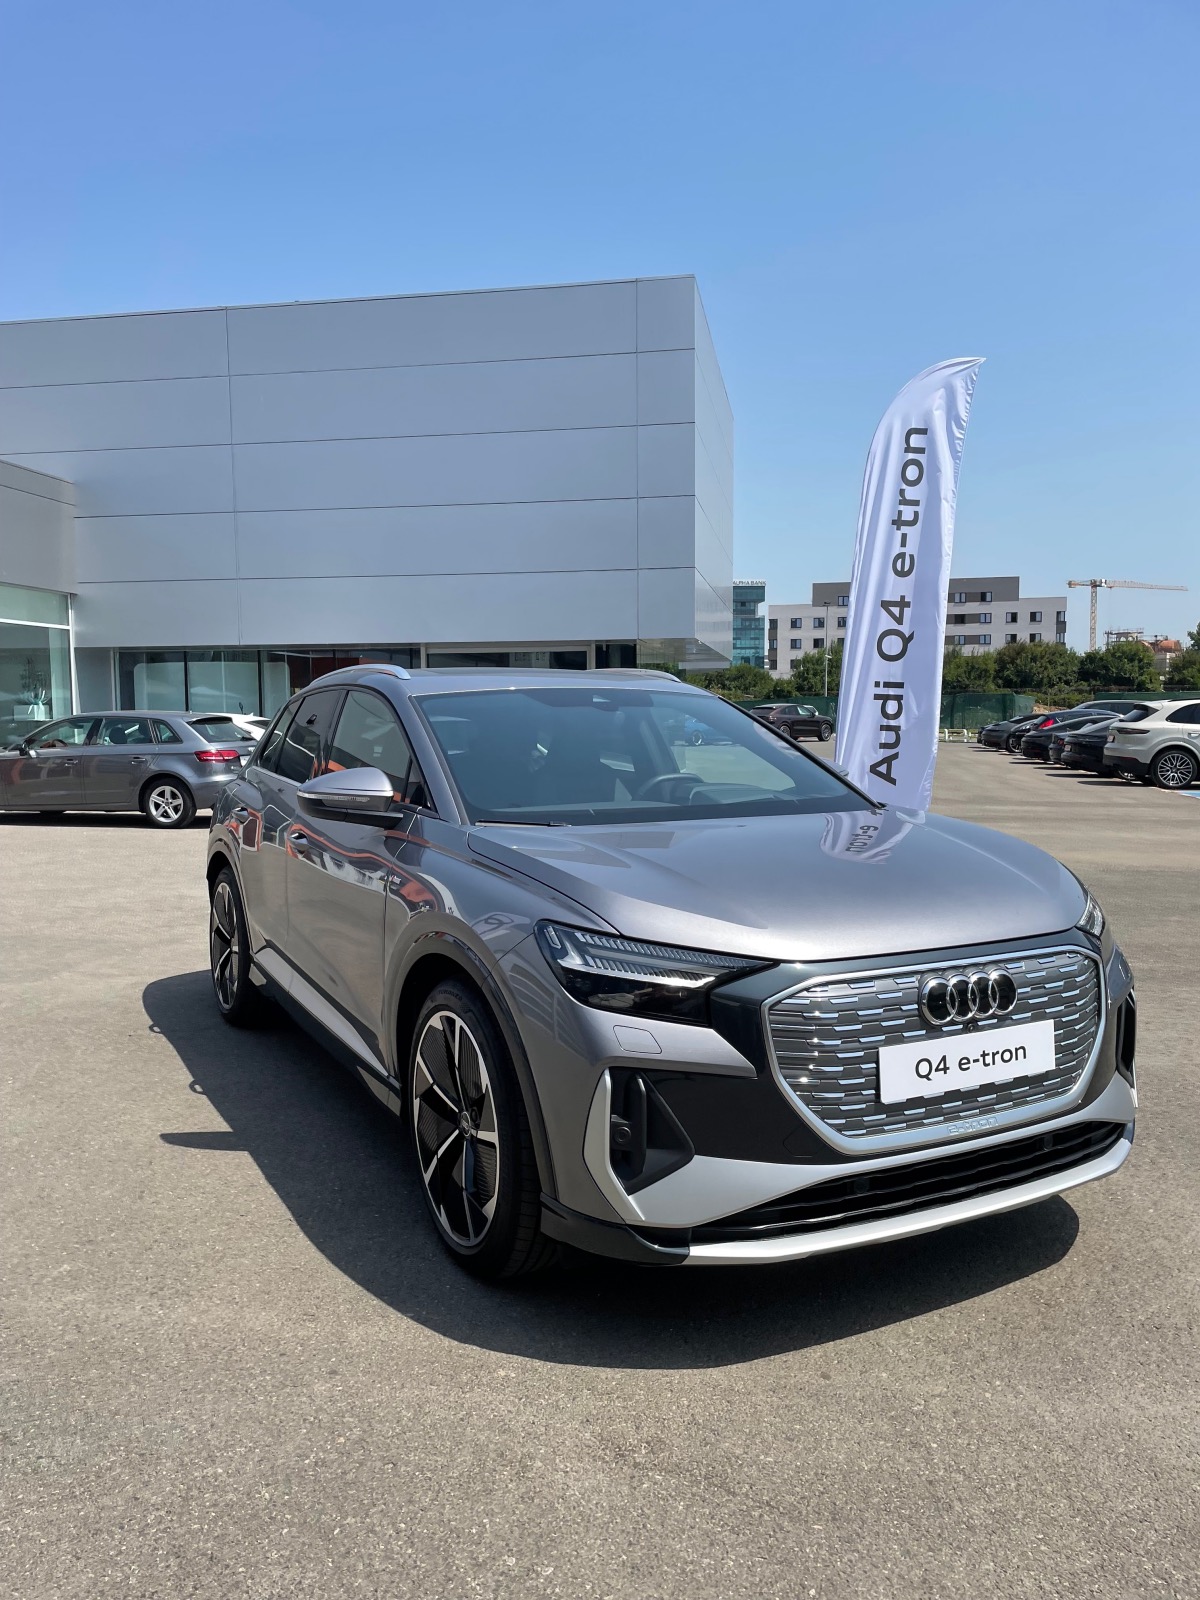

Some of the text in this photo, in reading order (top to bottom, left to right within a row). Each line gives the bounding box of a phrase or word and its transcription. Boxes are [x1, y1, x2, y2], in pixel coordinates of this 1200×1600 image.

[869, 426, 928, 786] Audi Q4 e-tron
[915, 1045, 1027, 1081] Q4 e-tron
